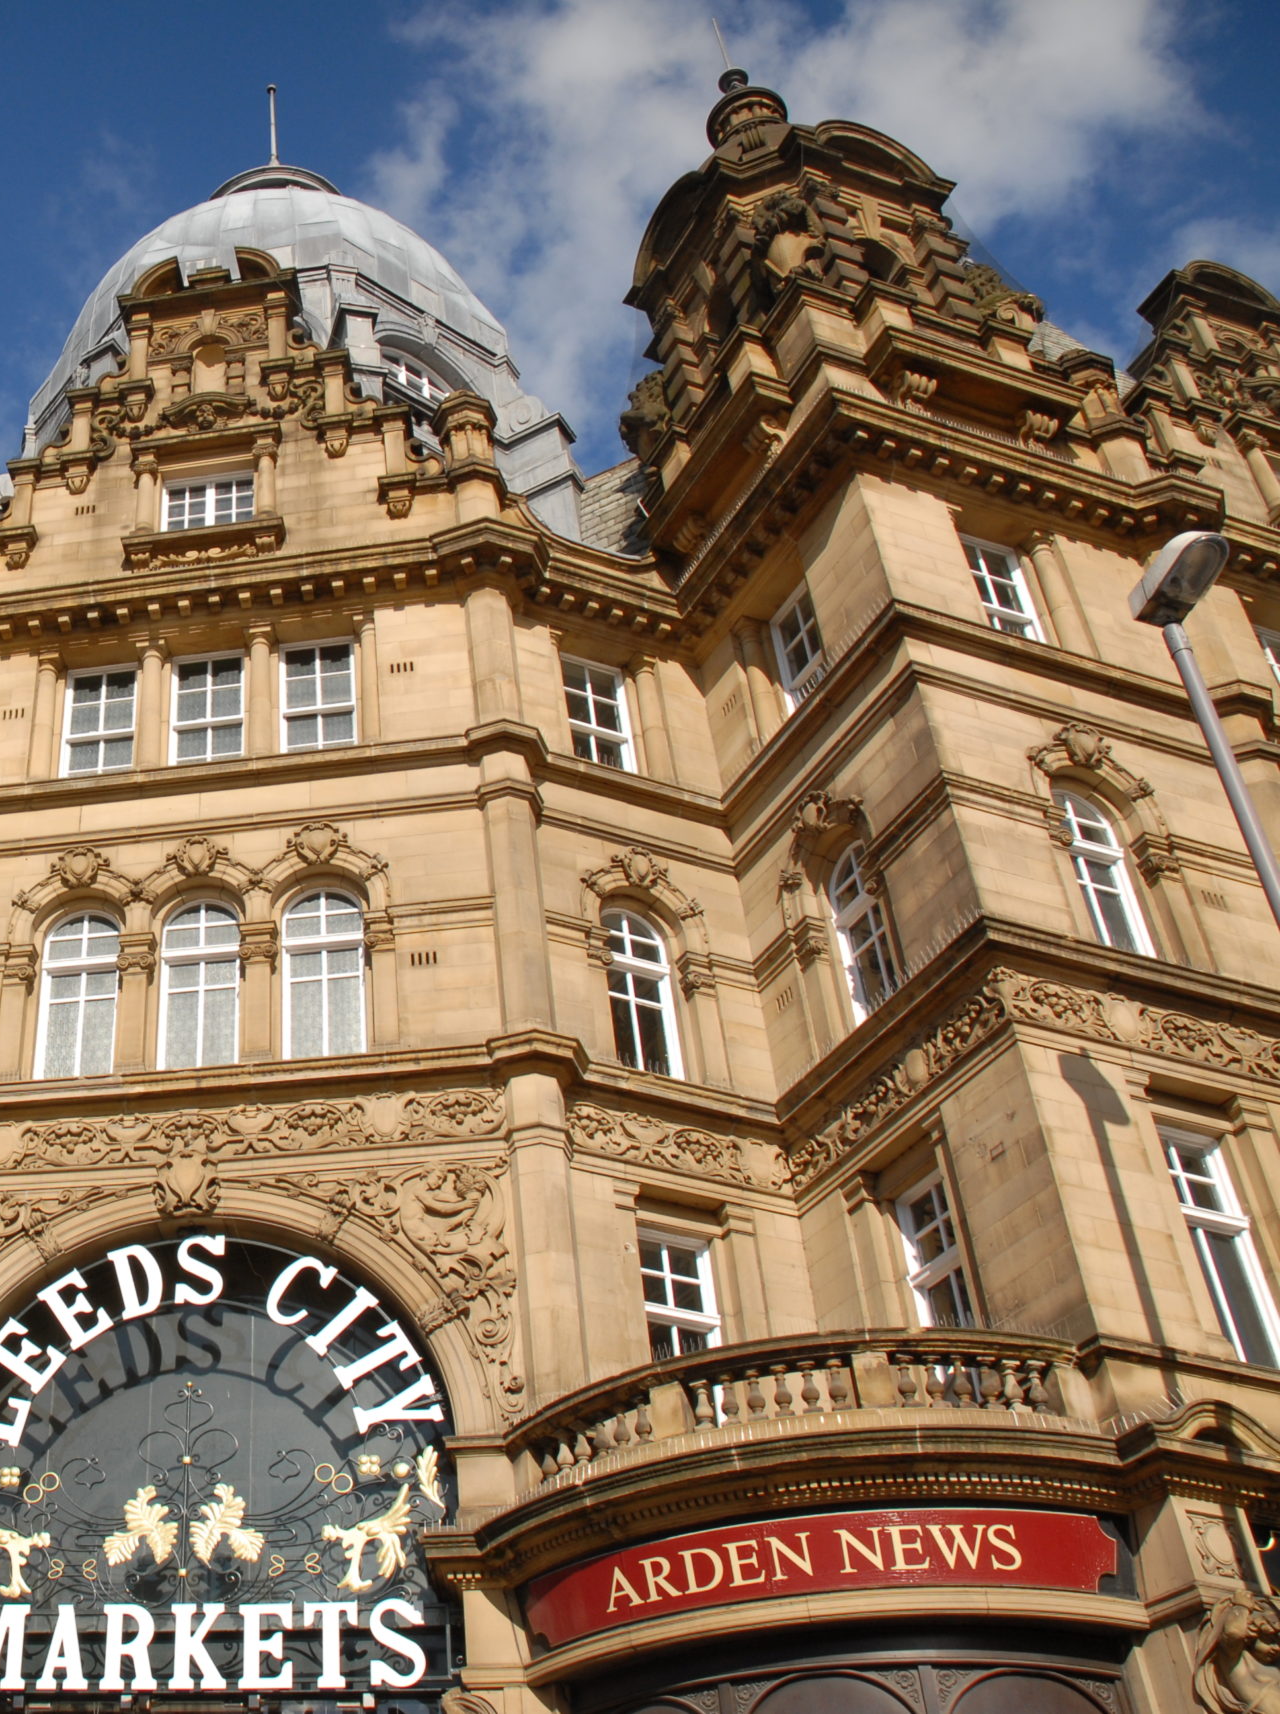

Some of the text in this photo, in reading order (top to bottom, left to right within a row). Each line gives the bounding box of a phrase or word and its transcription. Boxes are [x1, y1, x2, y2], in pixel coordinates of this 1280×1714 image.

[266, 1257, 444, 1433] CITY
[607, 1524, 1022, 1611] ARDEN NEWS
